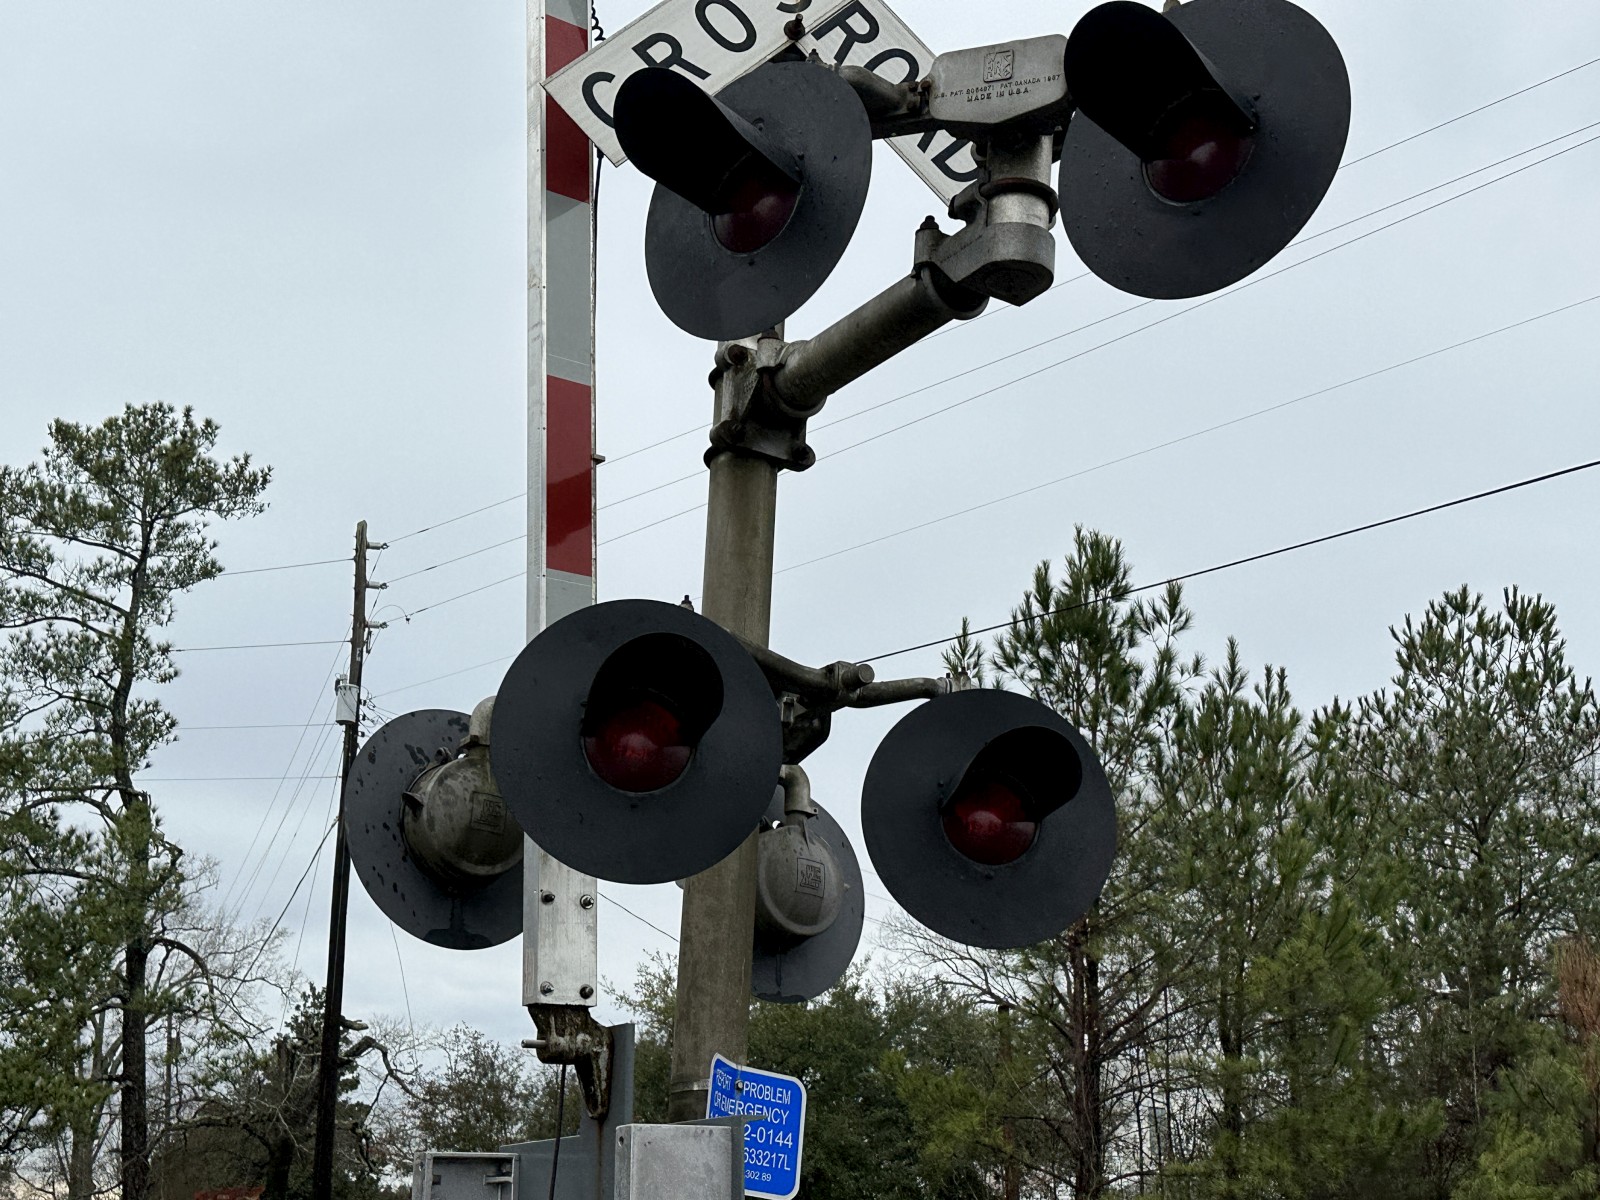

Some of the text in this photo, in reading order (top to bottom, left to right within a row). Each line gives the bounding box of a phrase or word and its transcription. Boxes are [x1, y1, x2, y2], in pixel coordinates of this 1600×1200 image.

[810, 0, 980, 183] ROD
[966, 93, 992, 102] MADE
[743, 1081, 791, 1105] PROBLEM
